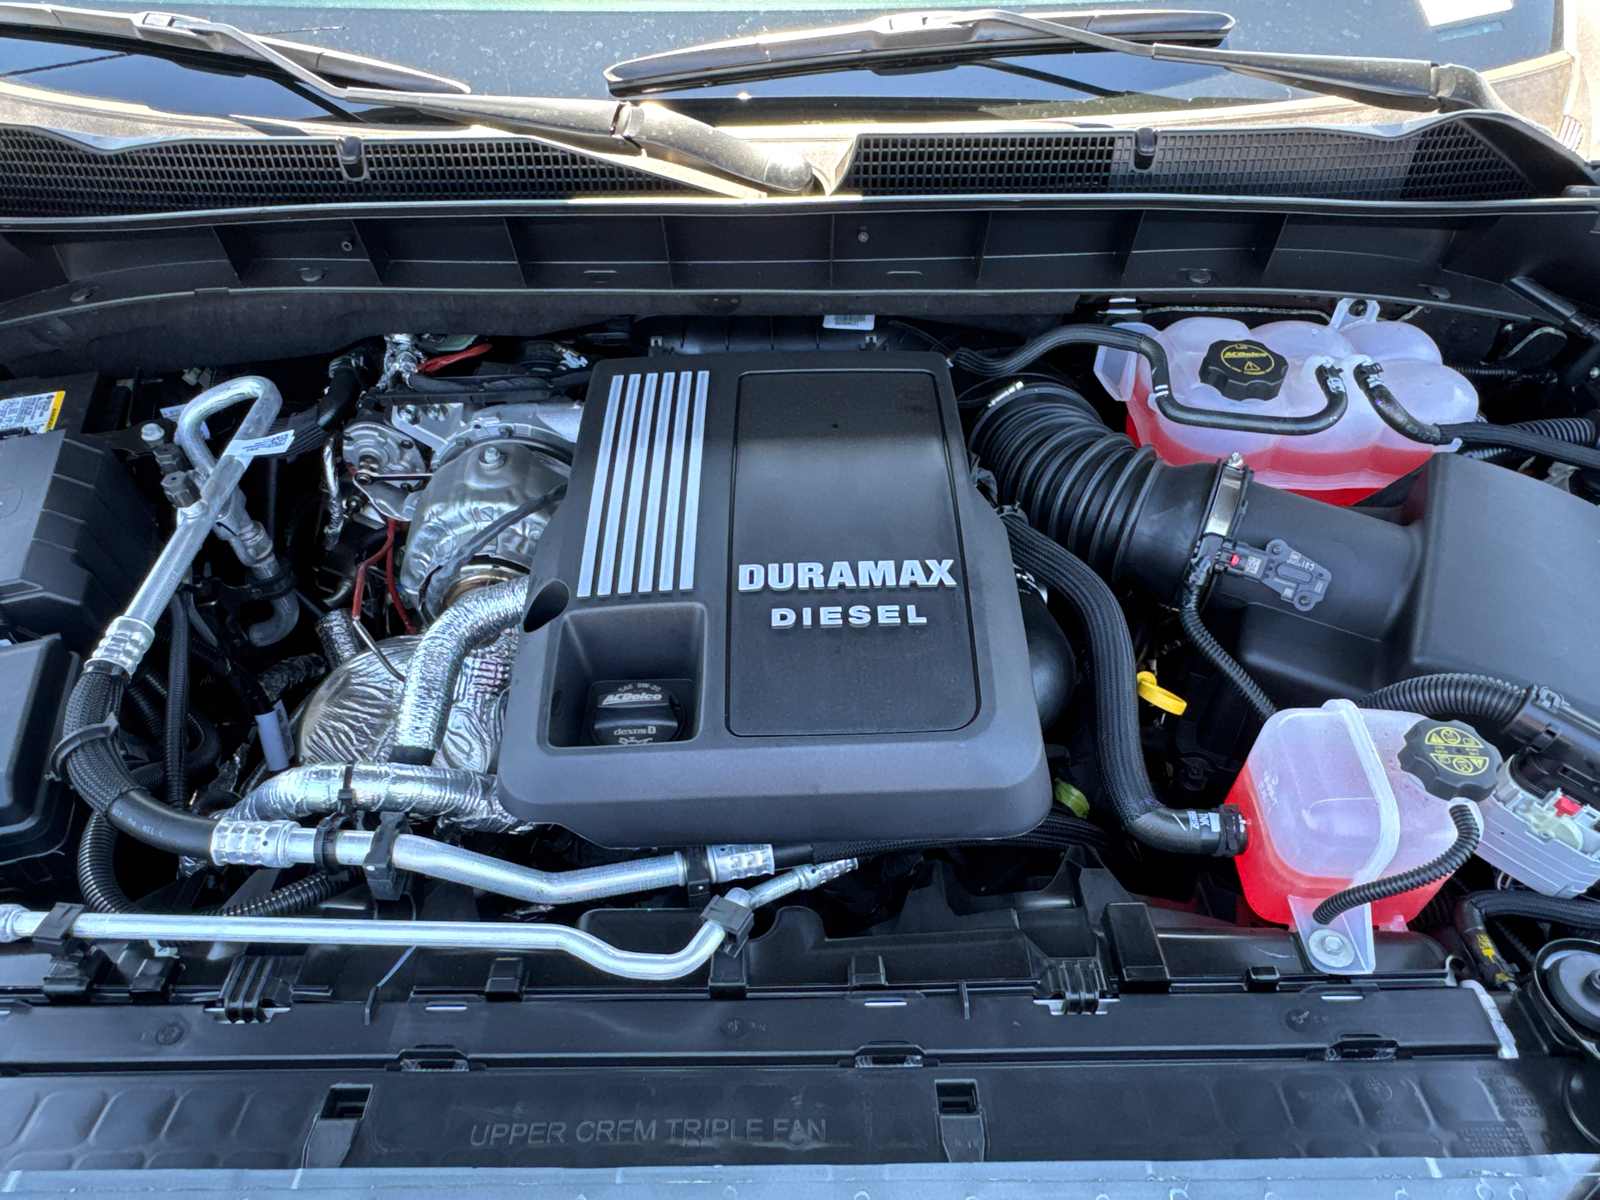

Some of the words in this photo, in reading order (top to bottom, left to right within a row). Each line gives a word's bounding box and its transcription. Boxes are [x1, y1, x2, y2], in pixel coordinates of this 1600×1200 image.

[1223, 351, 1268, 359] ACDelco
[738, 559, 957, 592] DURAMAX
[771, 604, 927, 629] DIESEL
[618, 683, 634, 692] SAE
[637, 682, 661, 692] 0W-20
[602, 692, 663, 705] ACDelco
[470, 1121, 567, 1147] UPPER
[575, 1119, 658, 1143] CRFM
[666, 1118, 764, 1141] TRIPLE
[773, 1118, 826, 1142] FAN
